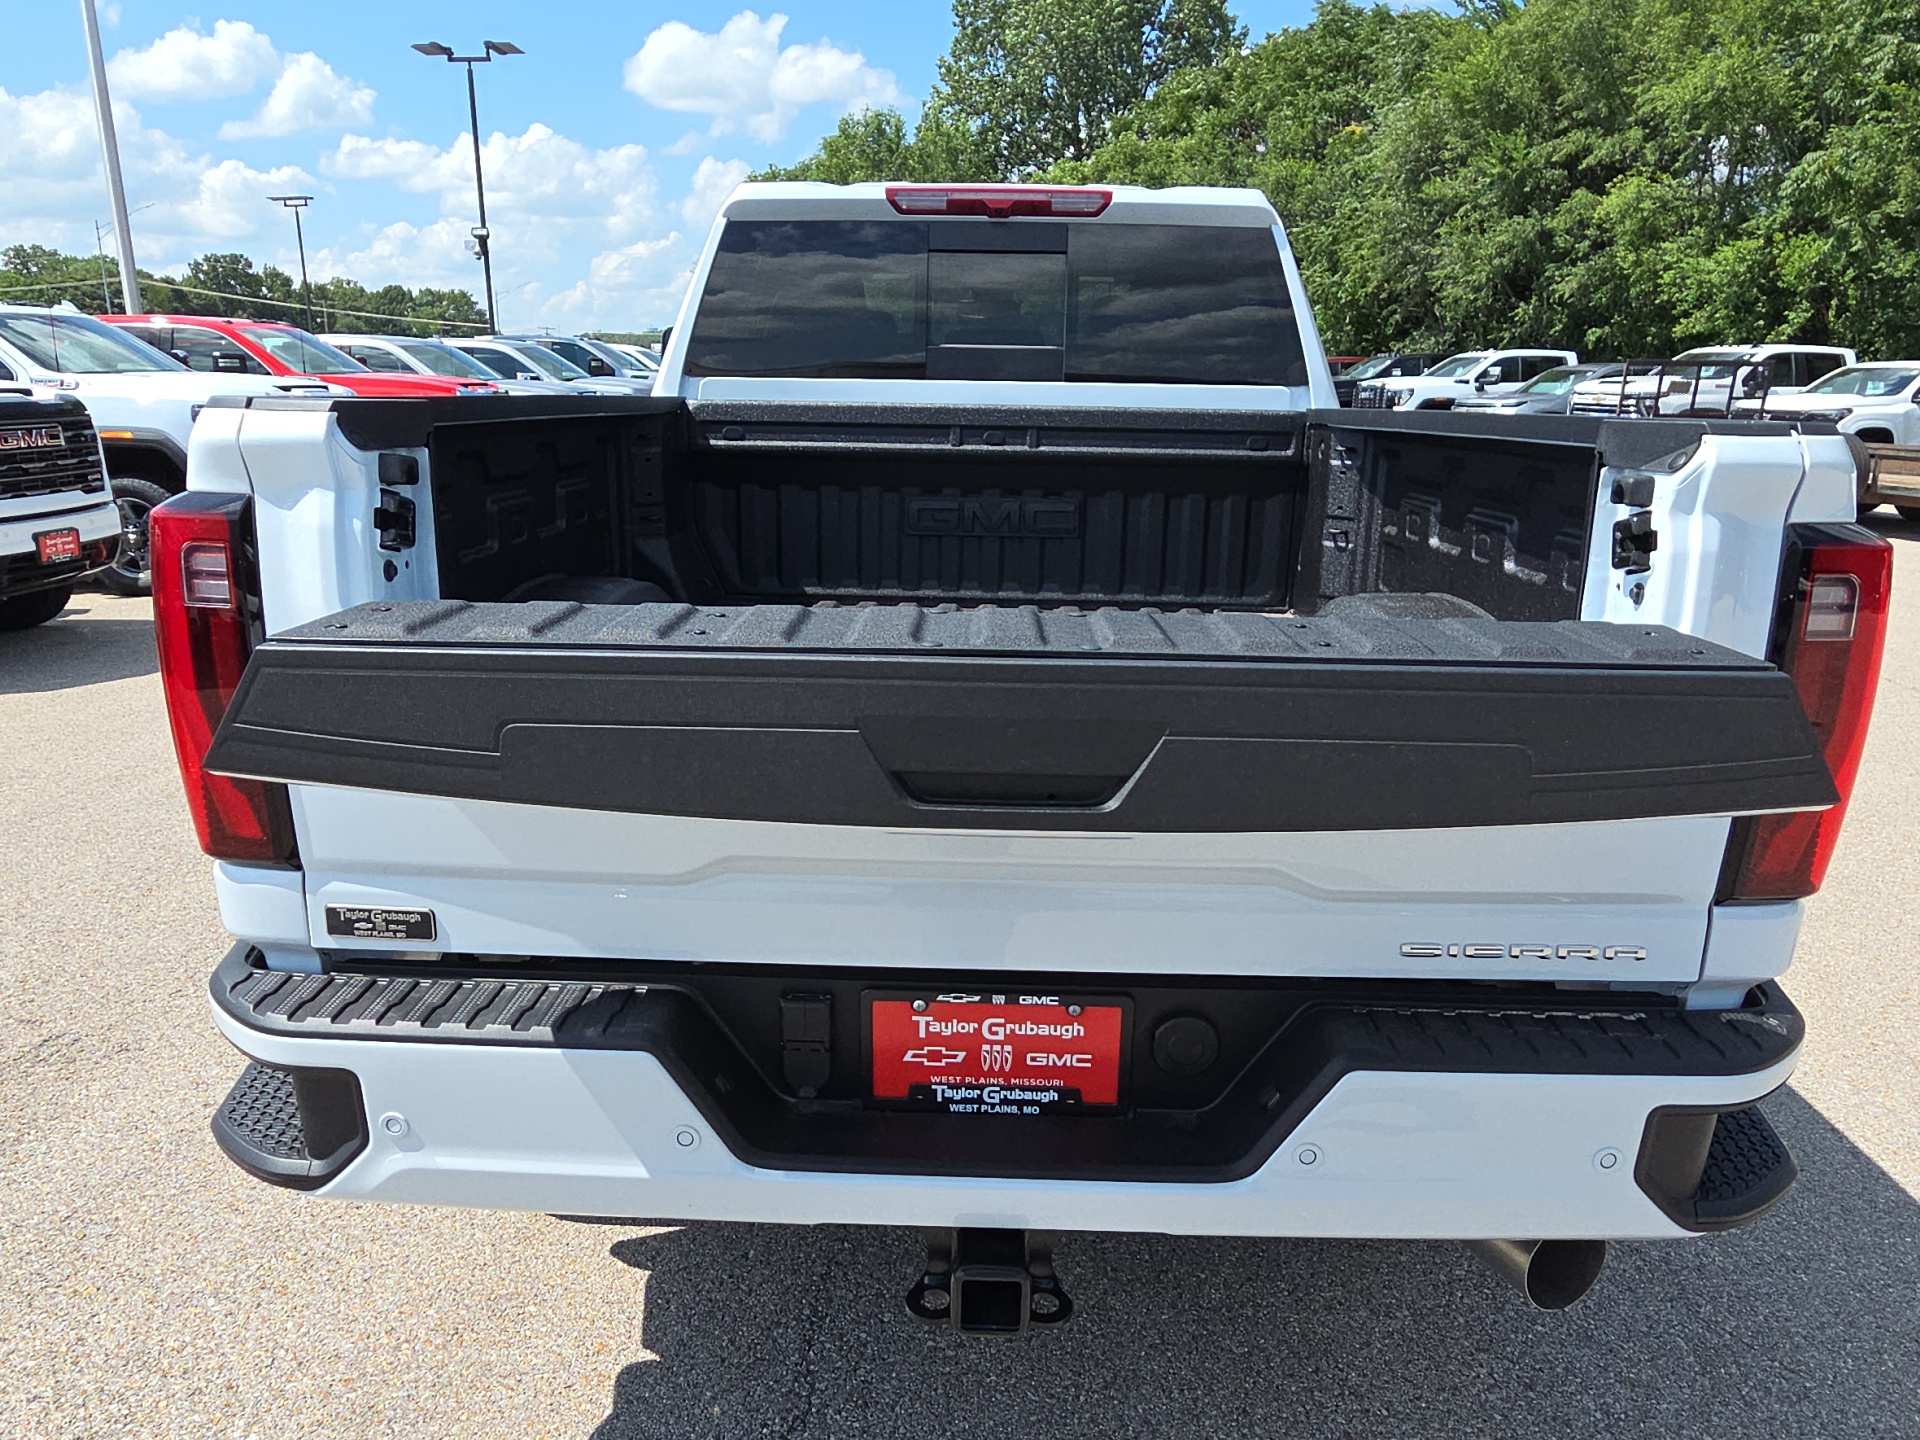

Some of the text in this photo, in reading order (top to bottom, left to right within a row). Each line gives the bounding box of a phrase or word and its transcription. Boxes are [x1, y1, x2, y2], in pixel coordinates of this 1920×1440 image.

[0, 429, 63, 449] GMC
[906, 501, 1078, 534] GMC
[337, 908, 421, 922] Taylor Grubaugh
[1400, 942, 1648, 960] SIERRA
[1019, 995, 1059, 1005] GMC
[912, 1016, 1085, 1040] Taylor Grubaugh
[1026, 1053, 1092, 1067] GMC
[930, 1075, 1064, 1087] WEST PLAINS, MISSOURI
[932, 1085, 1059, 1103] Taylor Grubaugh
[949, 1104, 1040, 1115] WEST PLAINS, MO
